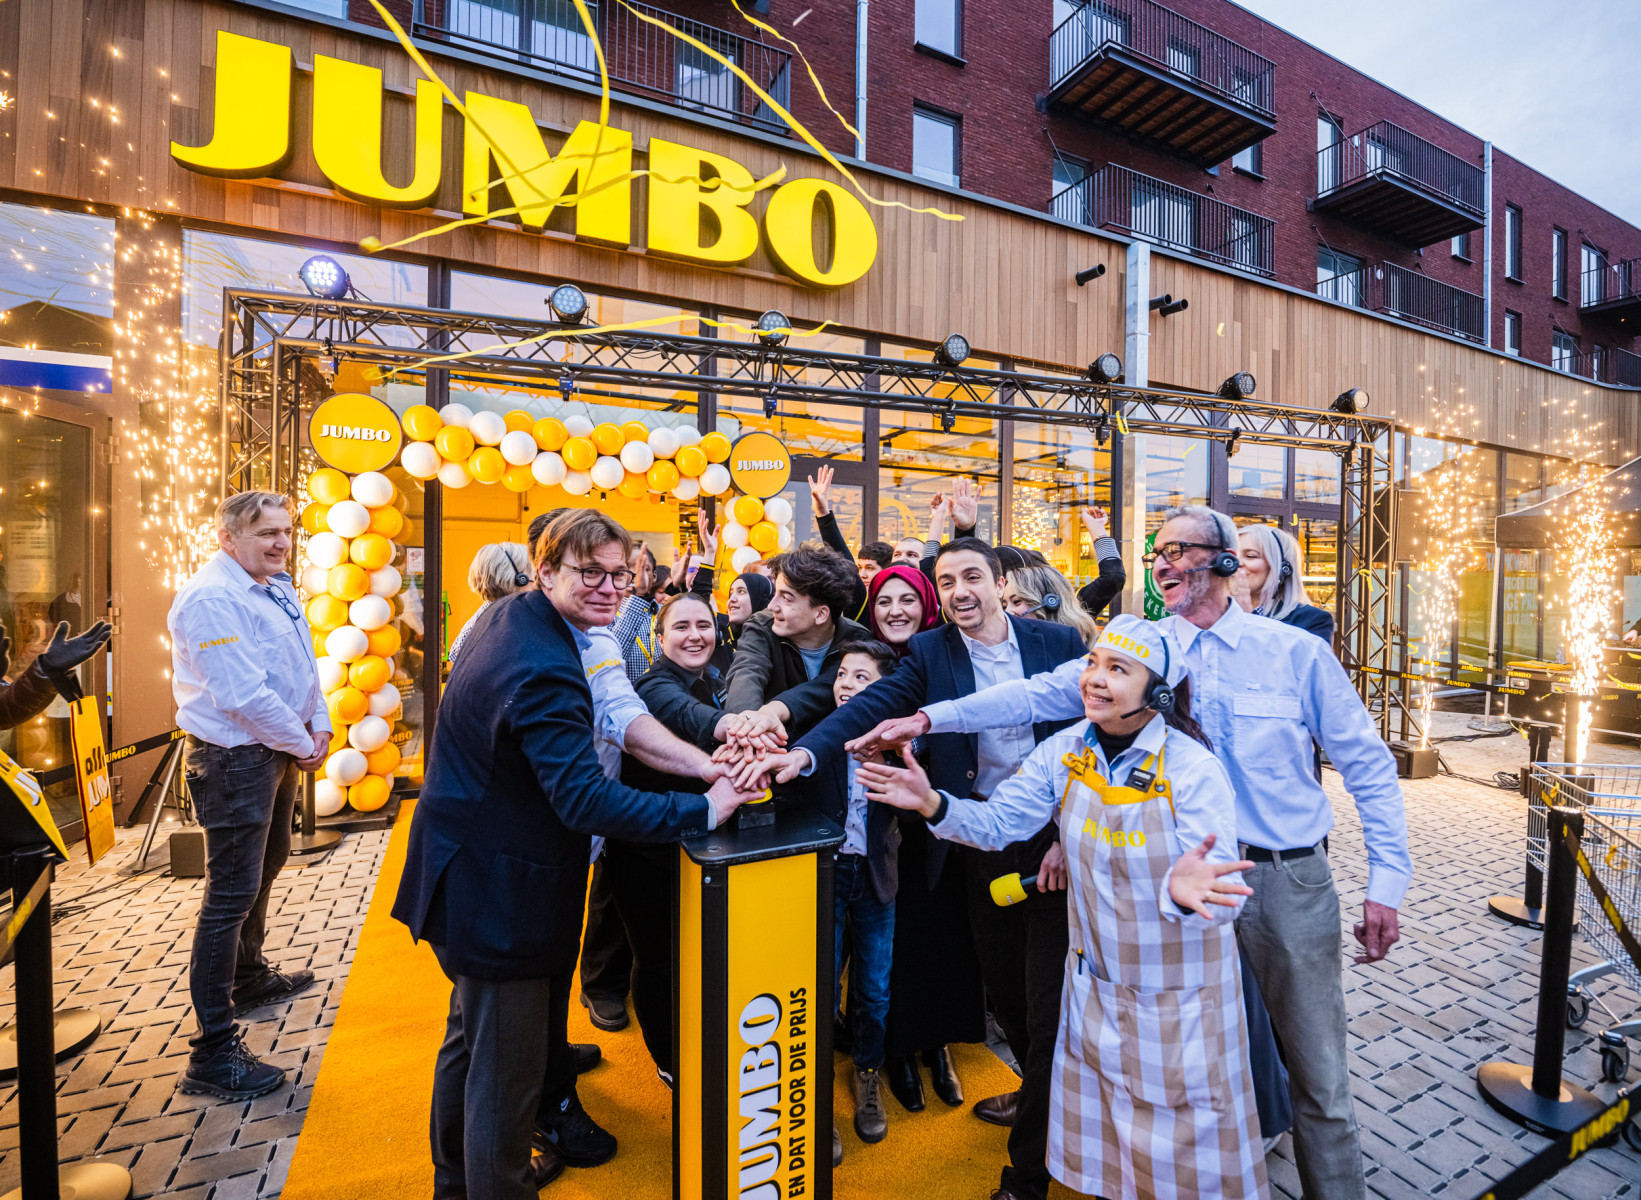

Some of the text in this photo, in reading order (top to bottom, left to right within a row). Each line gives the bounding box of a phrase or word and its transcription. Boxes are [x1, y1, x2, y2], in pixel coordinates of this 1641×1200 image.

[170, 29, 878, 287] JUMBO
[320, 424, 391, 442] JUMBO
[736, 459, 784, 471] JUMBO
[199, 636, 239, 650] JUMBO
[1360, 665, 1525, 696] JUMBO JUMBO JUMBO JUMBO
[1461, 665, 1484, 673] JUMBO
[1507, 670, 1532, 679] JUMBO
[105, 745, 137, 764] UMBO
[1082, 817, 1146, 847] JUMBO
[788, 987, 807, 1199] EN DAT VOOR DIE PRIJS
